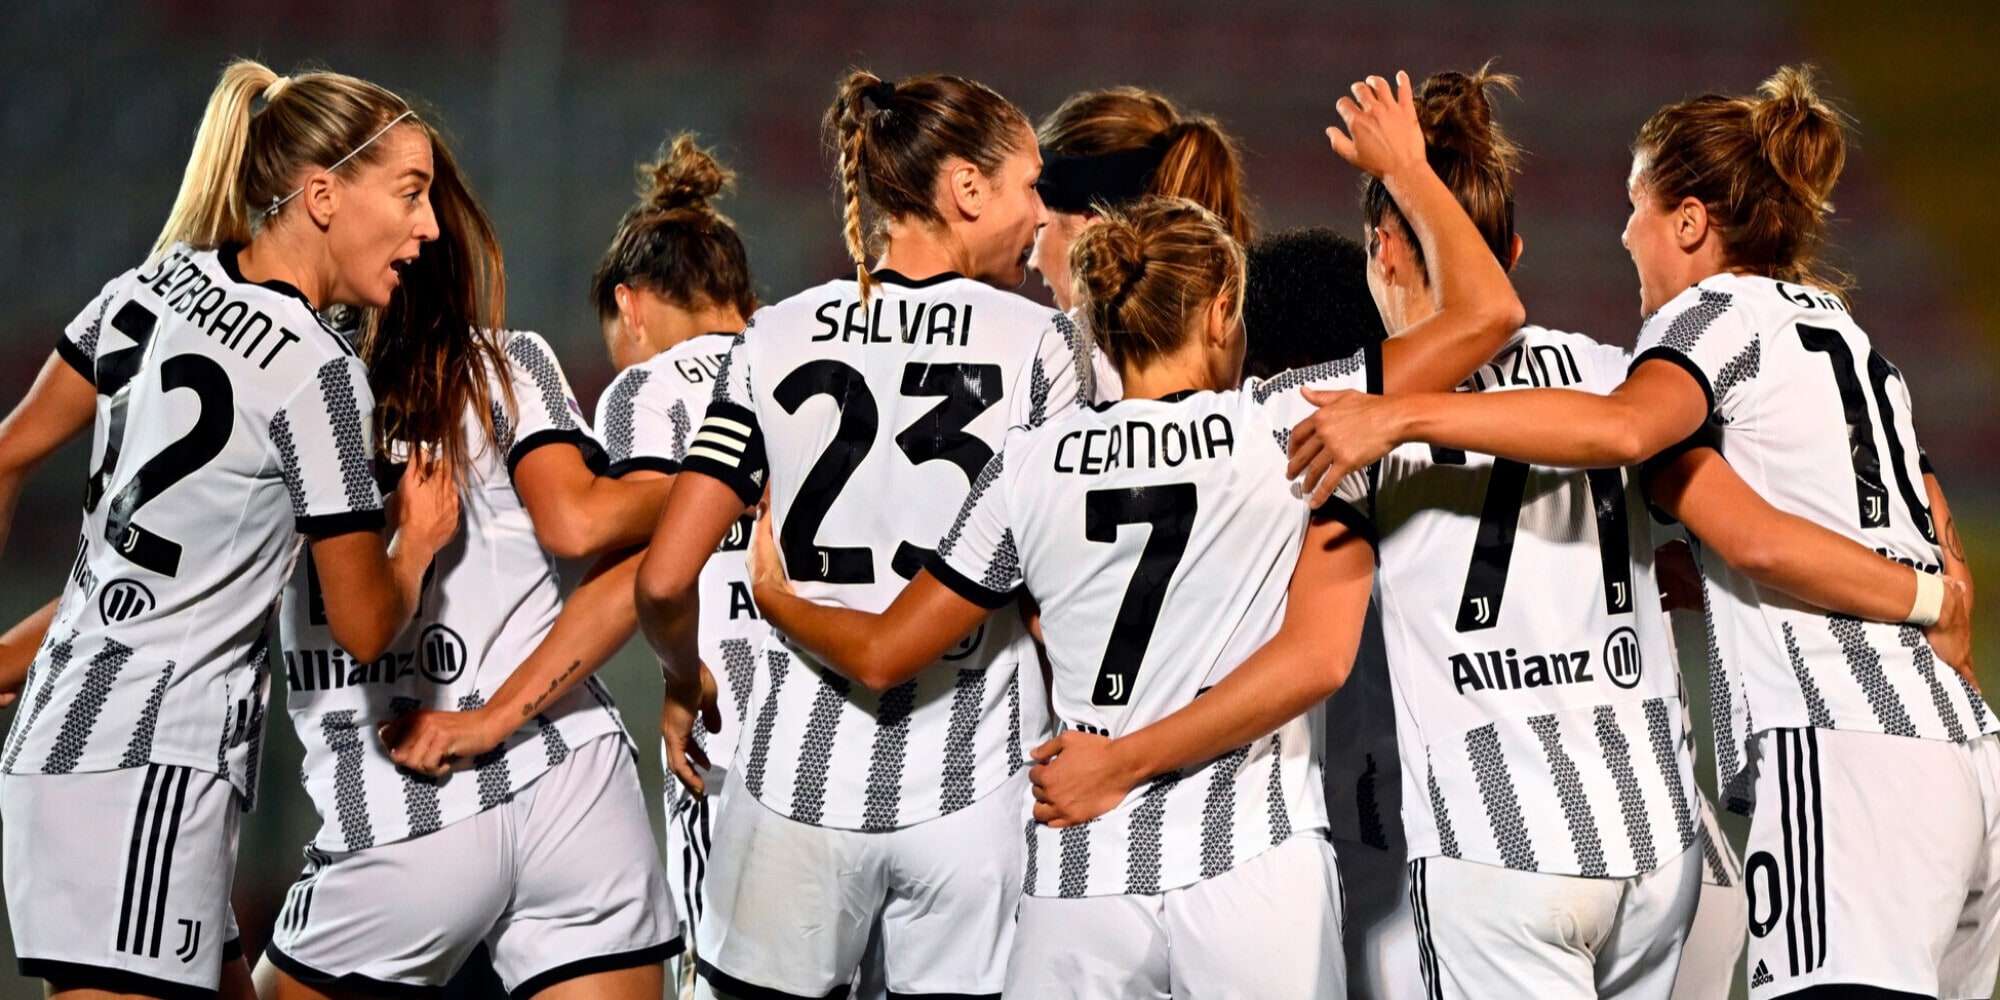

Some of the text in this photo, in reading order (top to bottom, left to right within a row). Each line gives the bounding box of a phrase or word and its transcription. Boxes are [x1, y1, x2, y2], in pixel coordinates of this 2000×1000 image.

[812, 299, 972, 346] SALVAI
[1452, 343, 1583, 392] NZINI
[1054, 413, 1234, 474] CERNOIA
[773, 359, 1003, 584] 23
[1086, 482, 1198, 706] 7
[1448, 648, 1594, 695] Allianz
